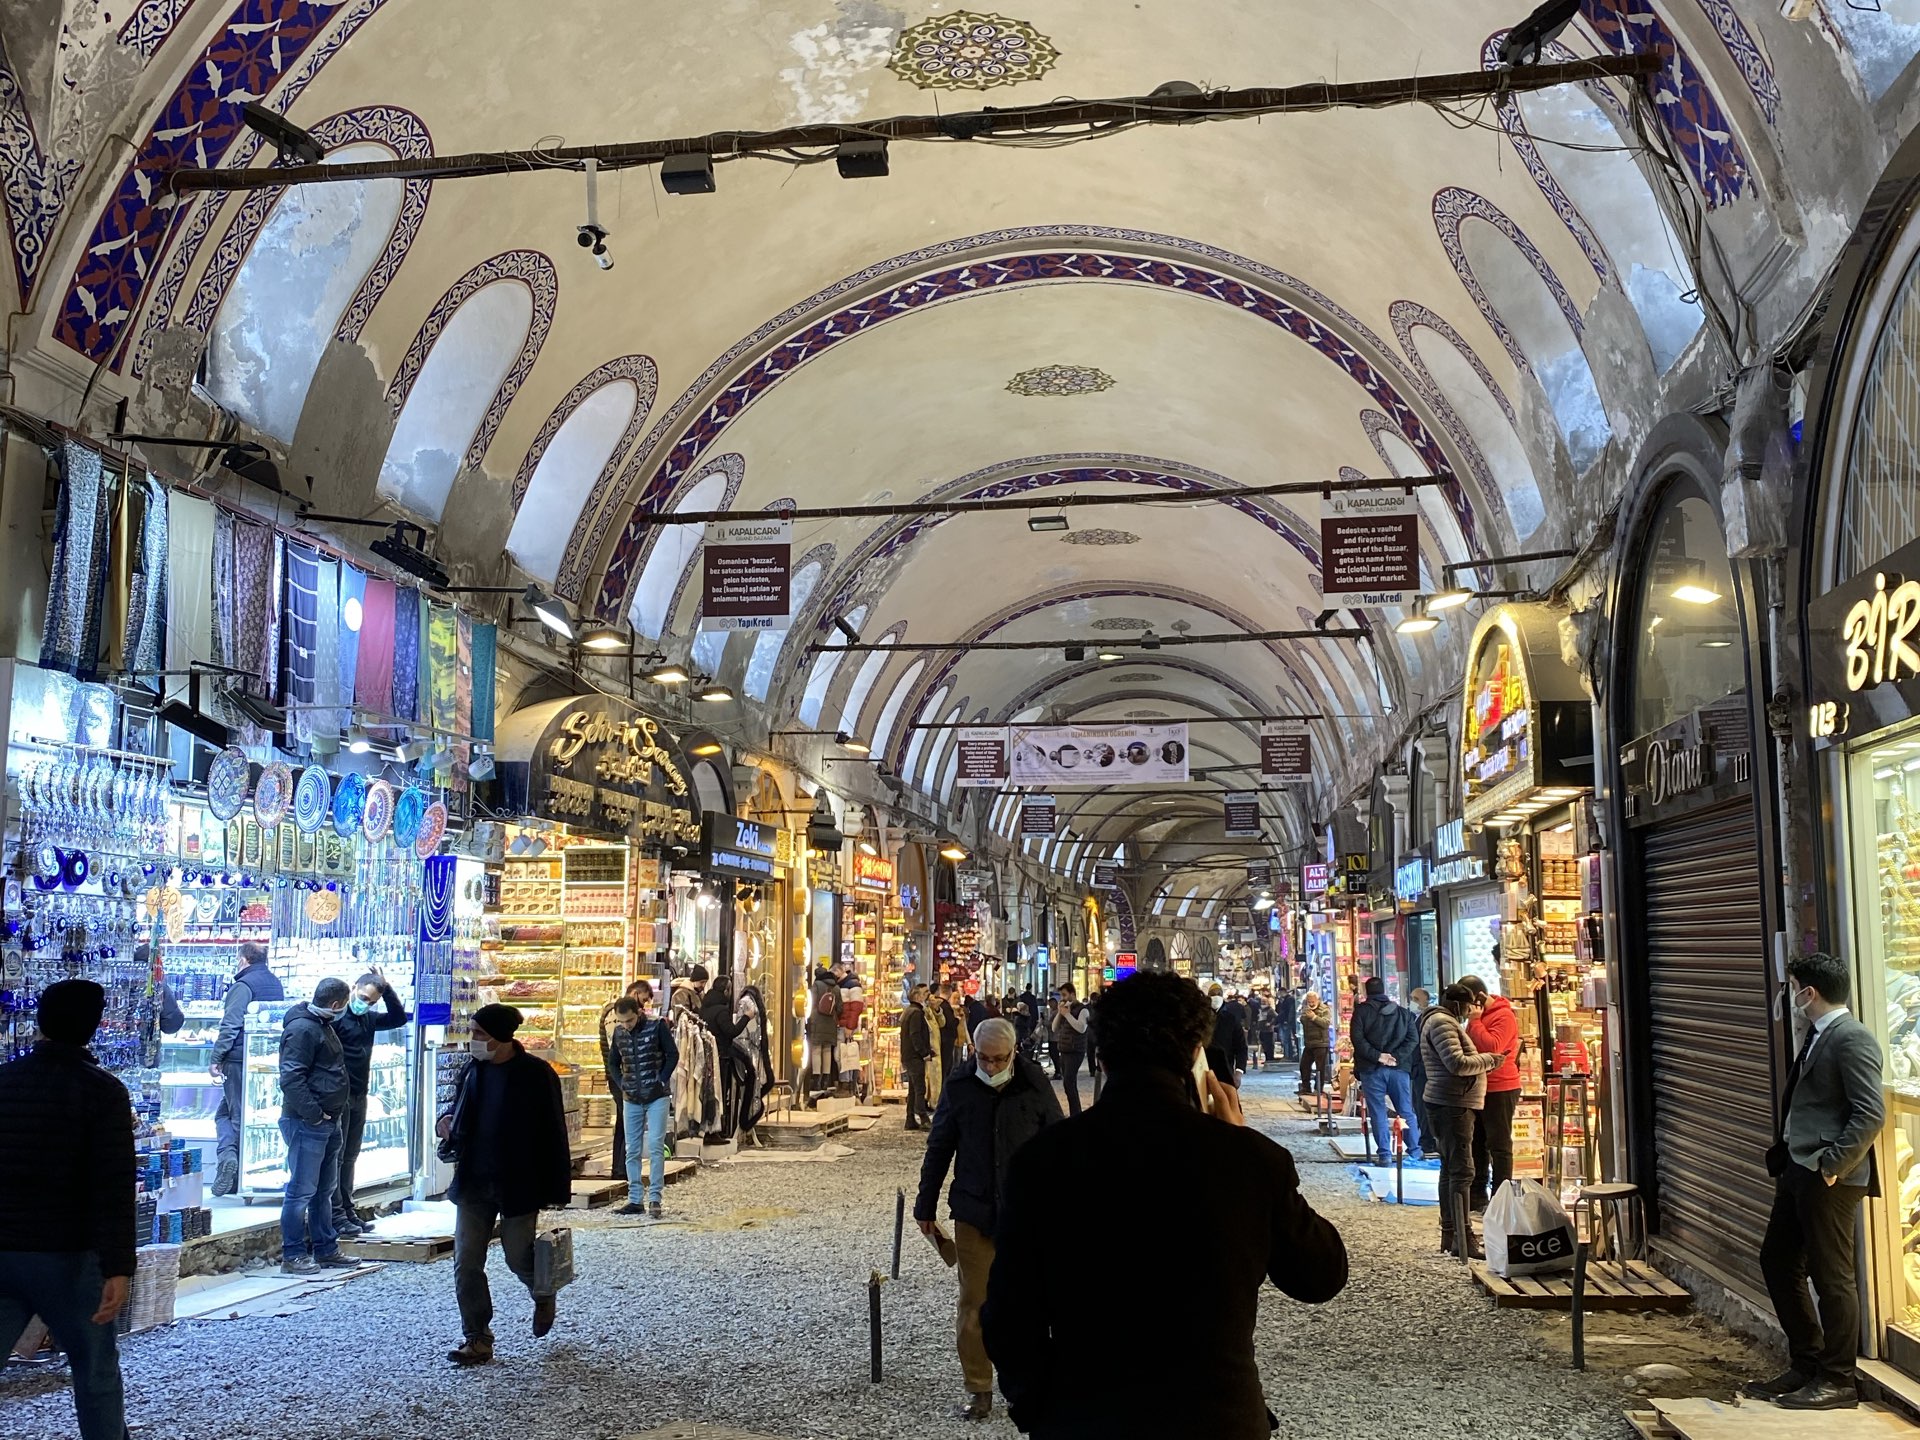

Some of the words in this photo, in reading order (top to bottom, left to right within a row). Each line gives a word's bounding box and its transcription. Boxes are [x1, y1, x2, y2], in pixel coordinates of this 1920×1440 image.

[1337, 527, 1370, 535] Bedesten,
[1378, 525, 1402, 533] vaulted
[1344, 536, 1356, 544] and
[1358, 535, 1396, 544] fireproofed
[1332, 546, 1361, 555] segment
[1339, 557, 1354, 565] gets
[745, 566, 784, 574] kelimesinden
[1348, 565, 1370, 574] (cloth)
[1336, 576, 1353, 584] cloth
[724, 586, 748, 594] (kumaş)
[740, 595, 780, 603] taşımaktadır.
[1809, 701, 1837, 738] 113
[1645, 740, 1703, 806] Diana
[735, 821, 759, 851] Zeki
[1437, 818, 1465, 859] HALUK
[1346, 854, 1369, 871] 101
[1309, 867, 1328, 878] ALT
[1521, 1237, 1561, 1258] ece
